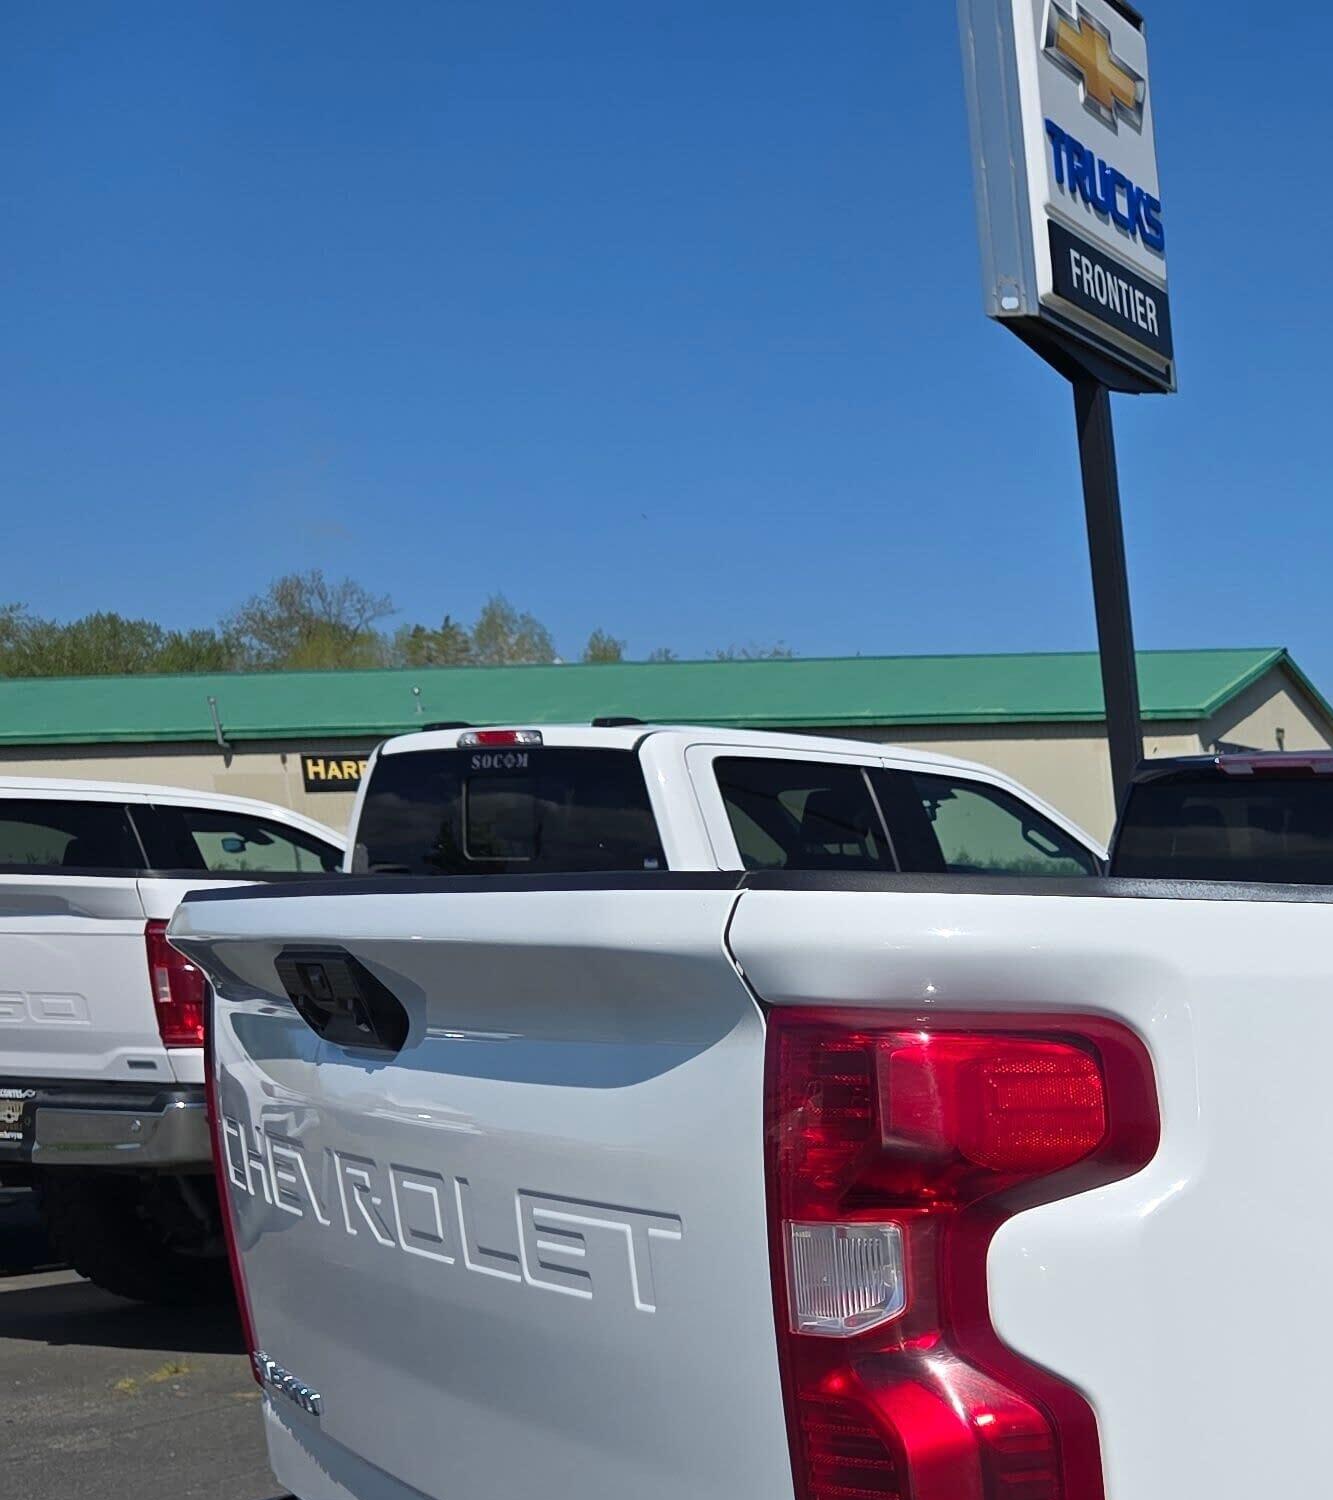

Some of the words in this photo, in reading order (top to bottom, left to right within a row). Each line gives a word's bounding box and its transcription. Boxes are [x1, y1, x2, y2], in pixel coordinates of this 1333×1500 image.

[1044, 118, 1164, 251] TRUCKS
[1070, 249, 1158, 336] FRONTIER
[221, 1115, 685, 1314] CHEVROLET
